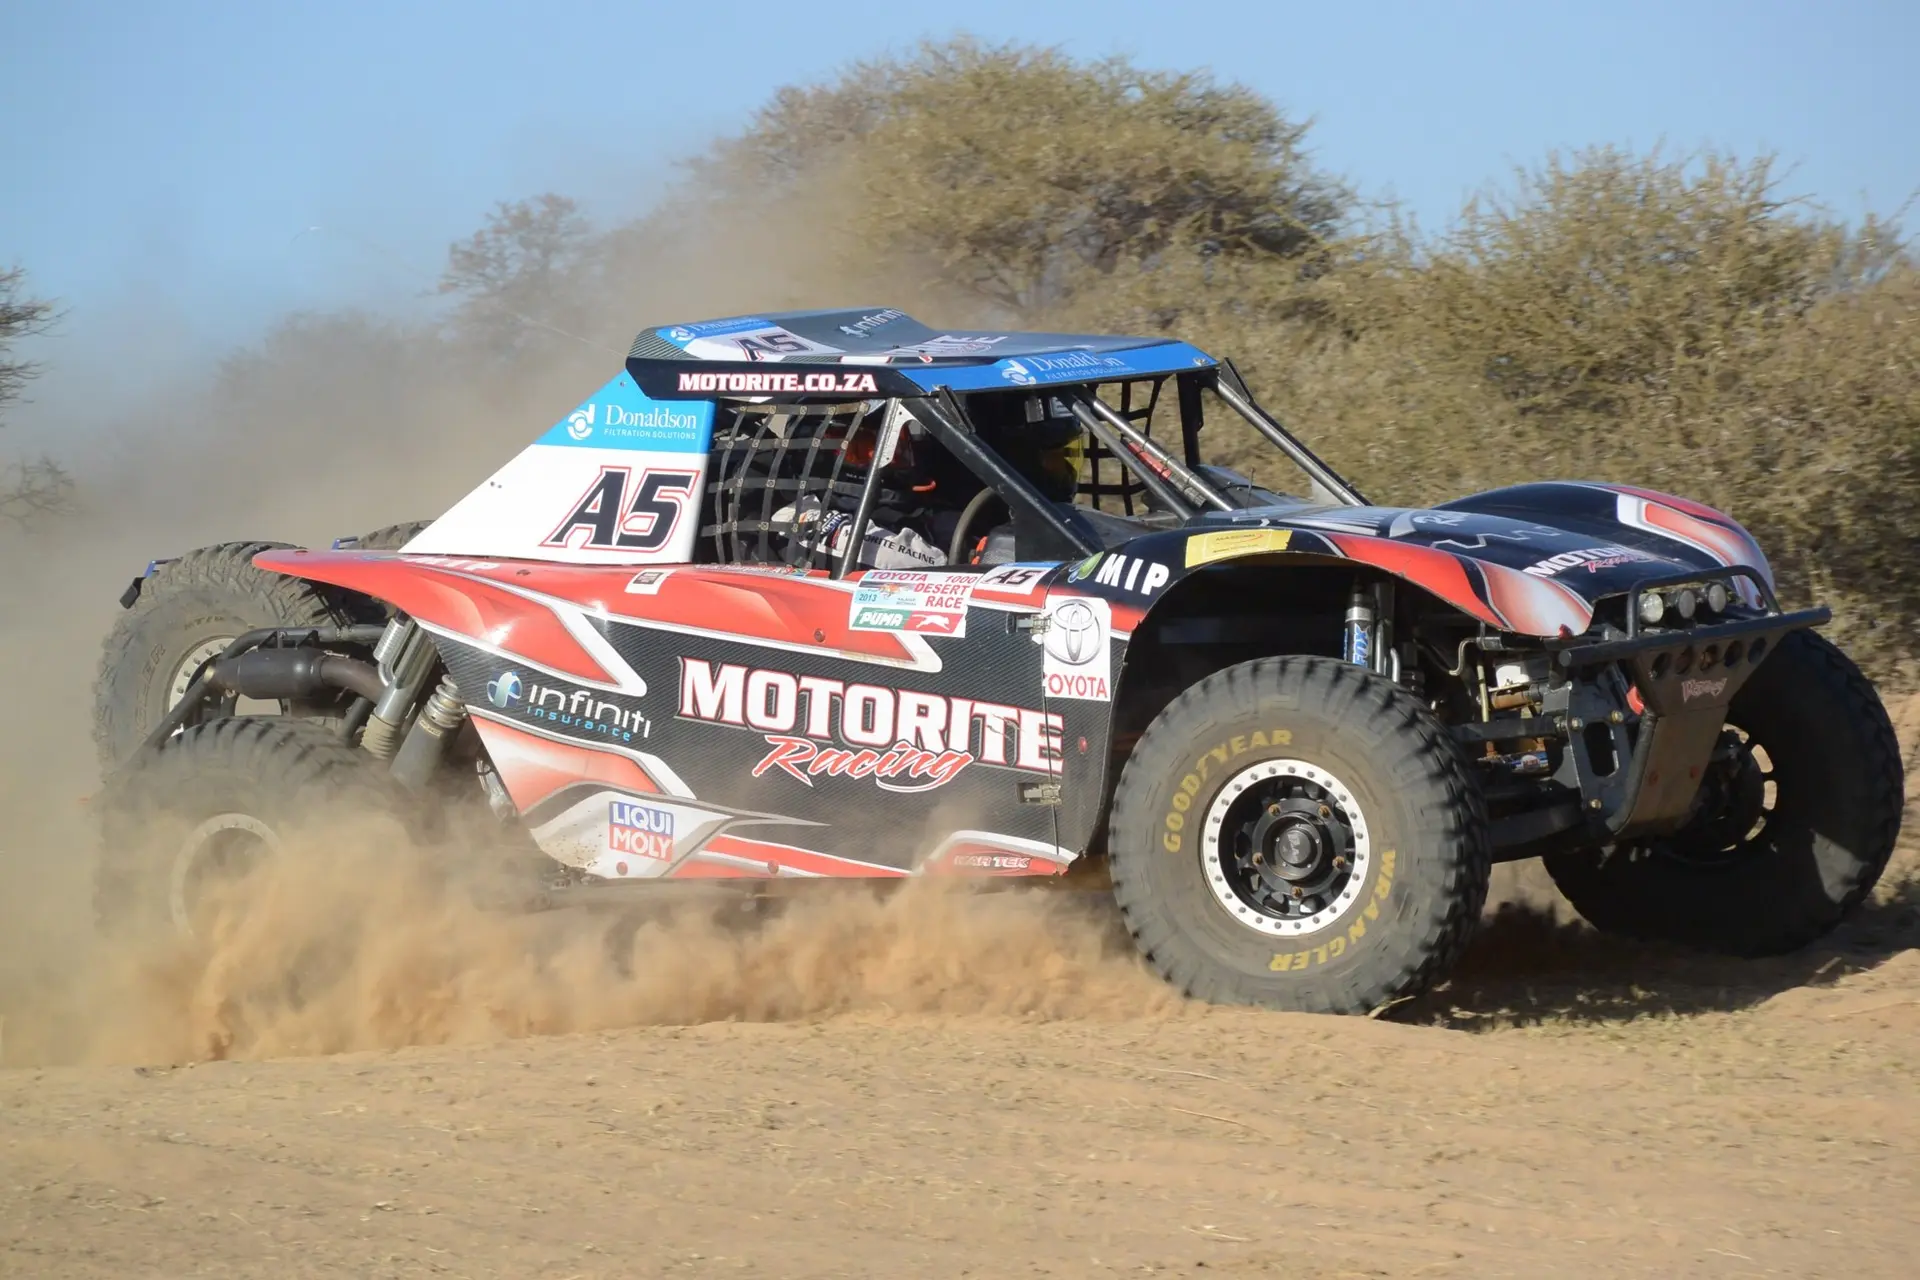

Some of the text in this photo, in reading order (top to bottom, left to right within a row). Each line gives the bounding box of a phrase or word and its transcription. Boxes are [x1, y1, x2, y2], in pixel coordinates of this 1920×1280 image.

[732, 332, 813, 361] A5
[677, 372, 878, 392] MOTORITE.CO.ZA
[605, 404, 697, 430] Donaldson
[604, 428, 696, 440] FILTRATION SOLUTIONS
[539, 466, 700, 553] A5
[898, 544, 936, 565] RACING
[871, 571, 977, 584] TOYOTA 1000
[983, 569, 1045, 586] A5
[1094, 553, 1170, 595] MIP
[858, 593, 877, 602] 2013
[914, 583, 970, 596] DESERT
[925, 597, 964, 609] RACE
[859, 612, 903, 627] PUMA
[526, 705, 632, 742] insurance
[529, 684, 651, 739] infiniti
[676, 657, 1064, 773] MOTORITE
[751, 734, 975, 793] Racing
[1163, 729, 1292, 853] GOODYEAR
[612, 802, 671, 835] LIQUI
[612, 827, 673, 858] MOLY
[1269, 850, 1396, 972] WRANGLER
